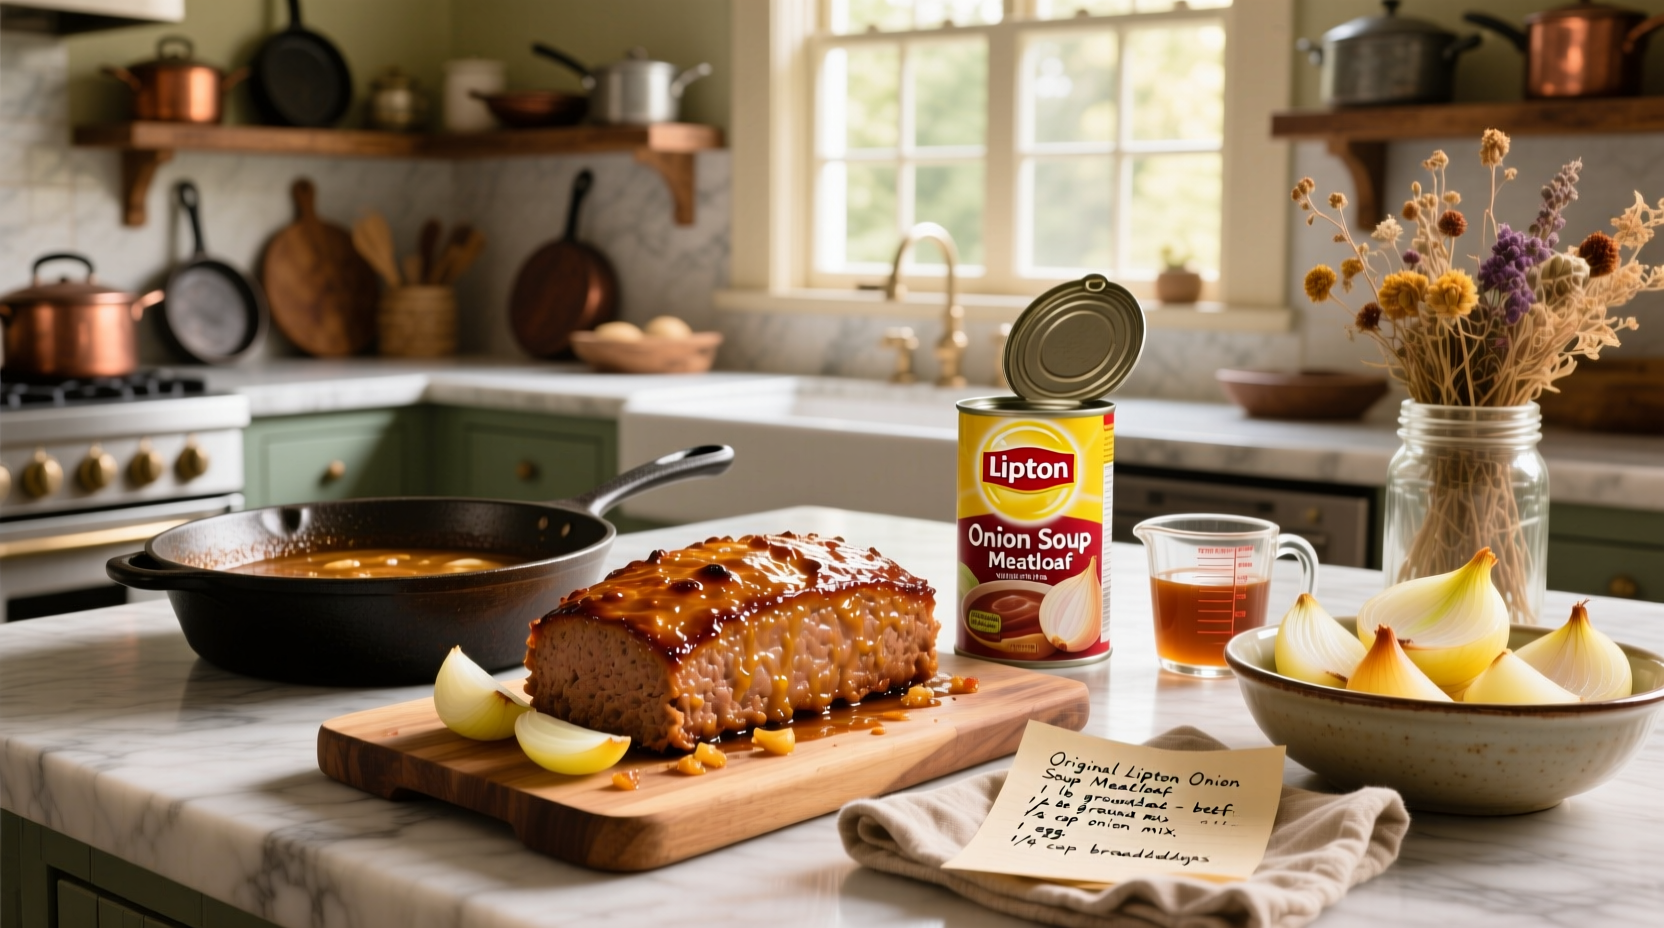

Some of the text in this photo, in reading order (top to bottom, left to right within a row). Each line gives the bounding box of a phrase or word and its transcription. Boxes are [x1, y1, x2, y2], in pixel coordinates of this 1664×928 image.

[989, 454, 1069, 484] Lipton
[968, 523, 1092, 555] Onion Soup
[988, 551, 1074, 571] Meatloaf
[1041, 767, 1082, 788] Soup
[1049, 751, 1241, 788] Original Lipton Onion
[1087, 818, 1130, 831] onion
